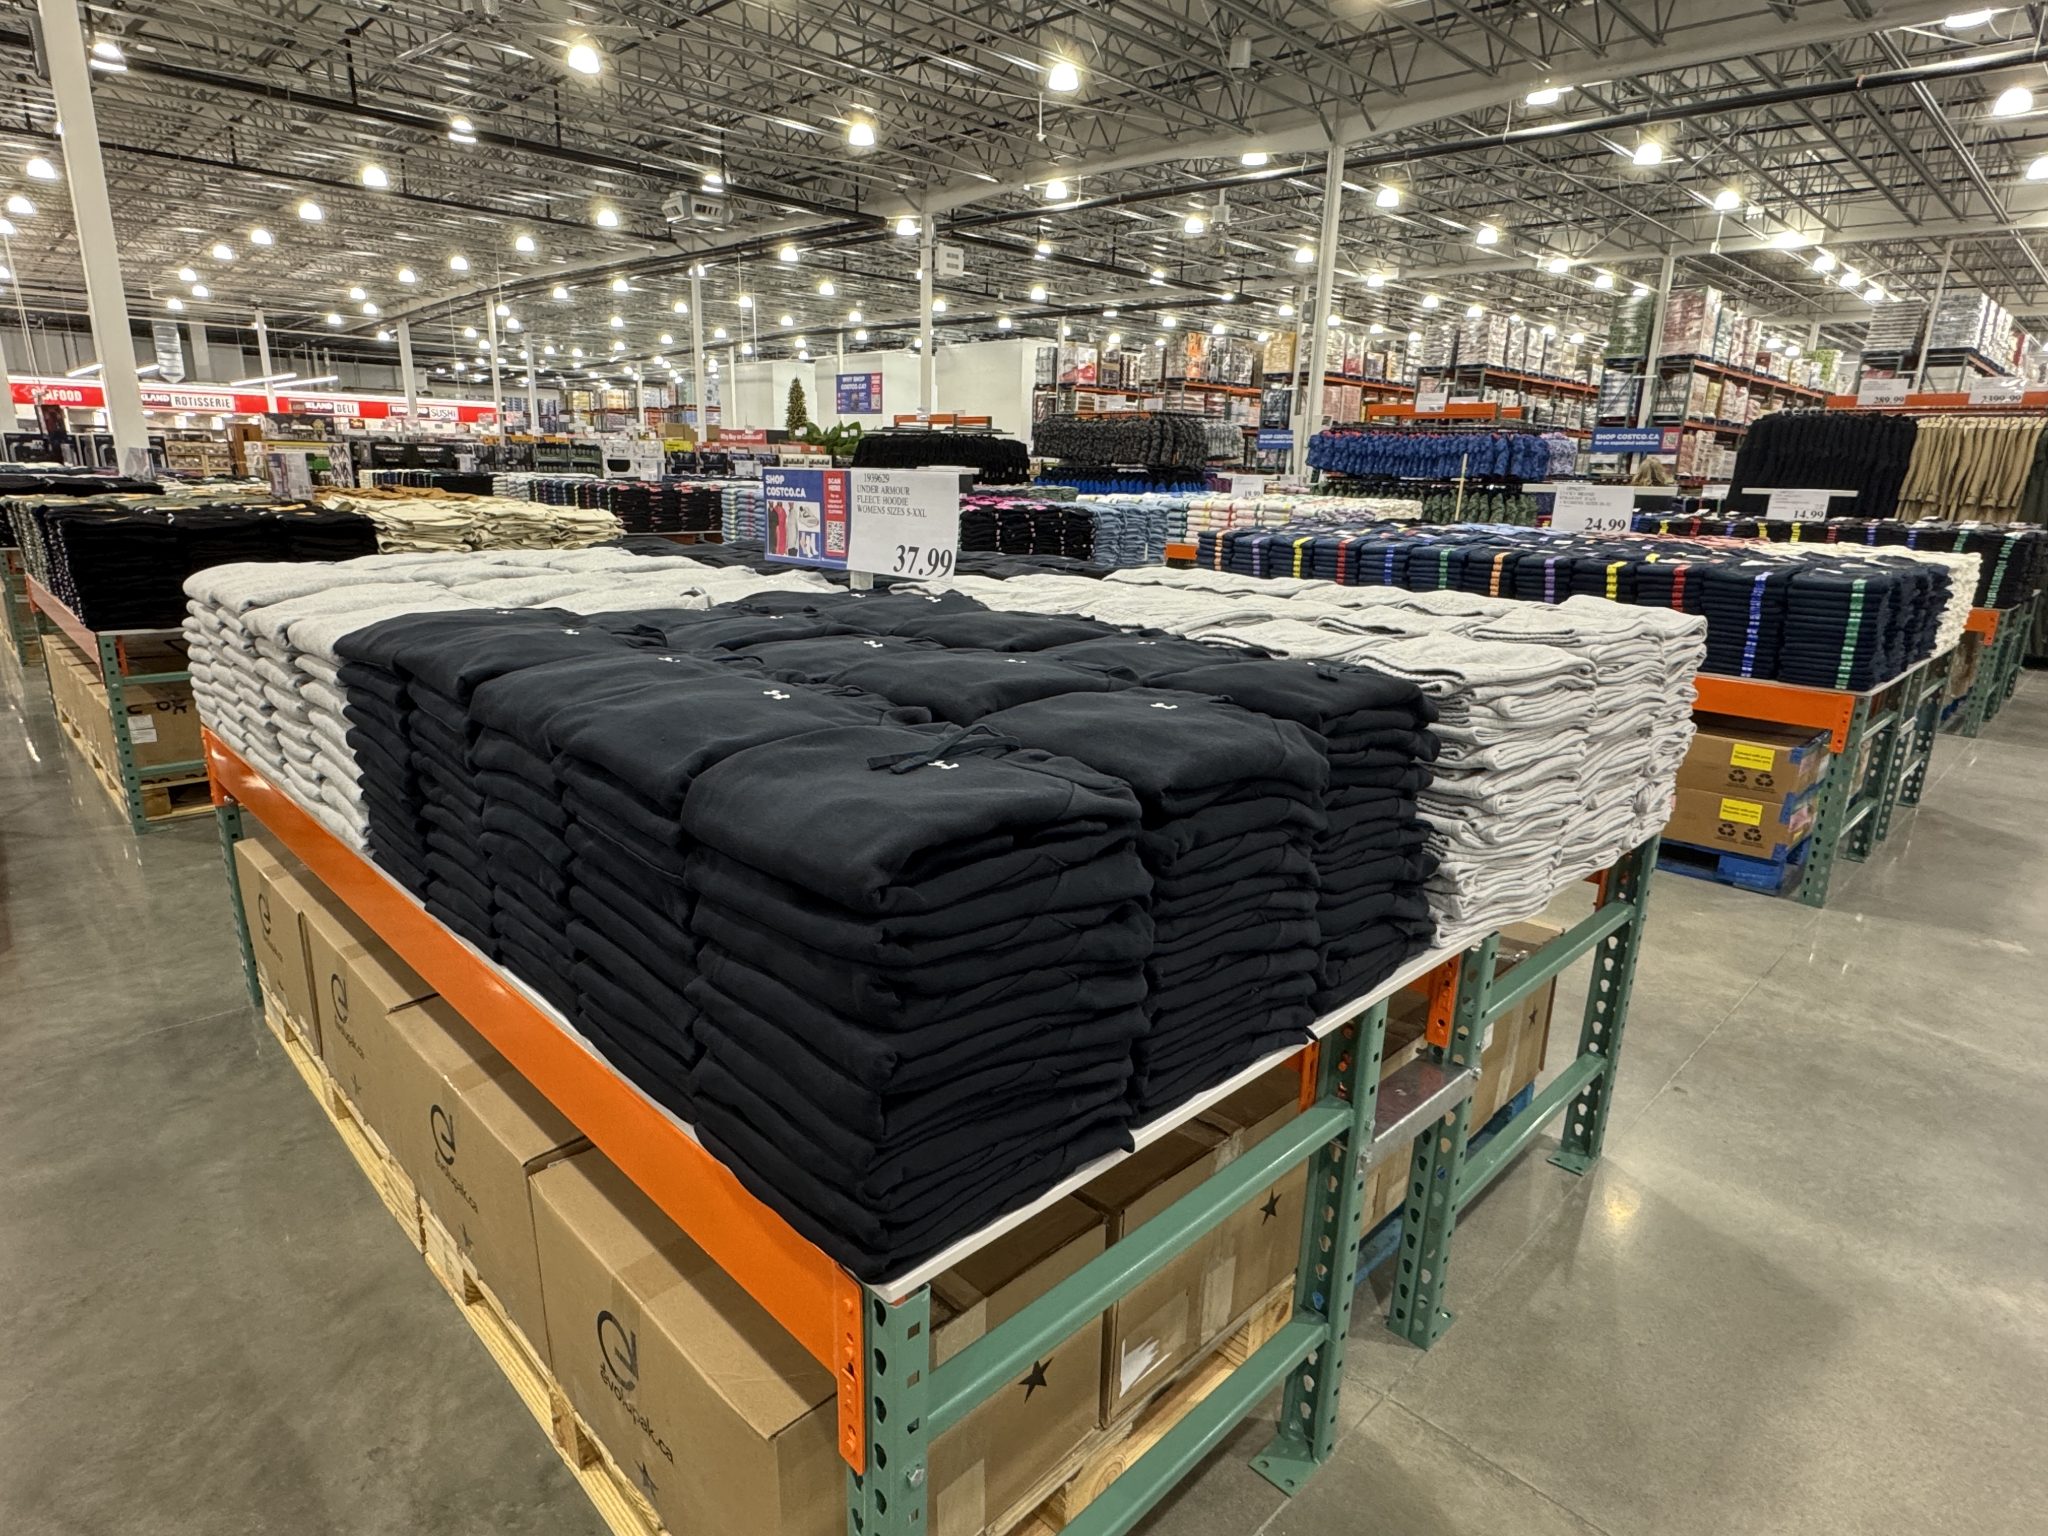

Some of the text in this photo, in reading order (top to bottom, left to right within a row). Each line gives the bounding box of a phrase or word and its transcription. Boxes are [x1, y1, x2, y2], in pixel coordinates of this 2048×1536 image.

[31, 388, 82, 402] SAFOOD
[174, 396, 231, 408] ROTISSERIE
[336, 404, 355, 414] DELI
[765, 474, 785, 485] SHOP
[864, 473, 890, 483] 1939629
[766, 486, 807, 498] COSTCO.CA
[856, 484, 910, 495] UNDER ARMOUR
[856, 494, 909, 506] FLEECE HOODIE
[856, 504, 928, 518] WOMENS SIZES S-XXL
[1793, 510, 1824, 519] 14.99
[1584, 517, 1627, 532] 24.99
[893, 544, 953, 578] 37.99
